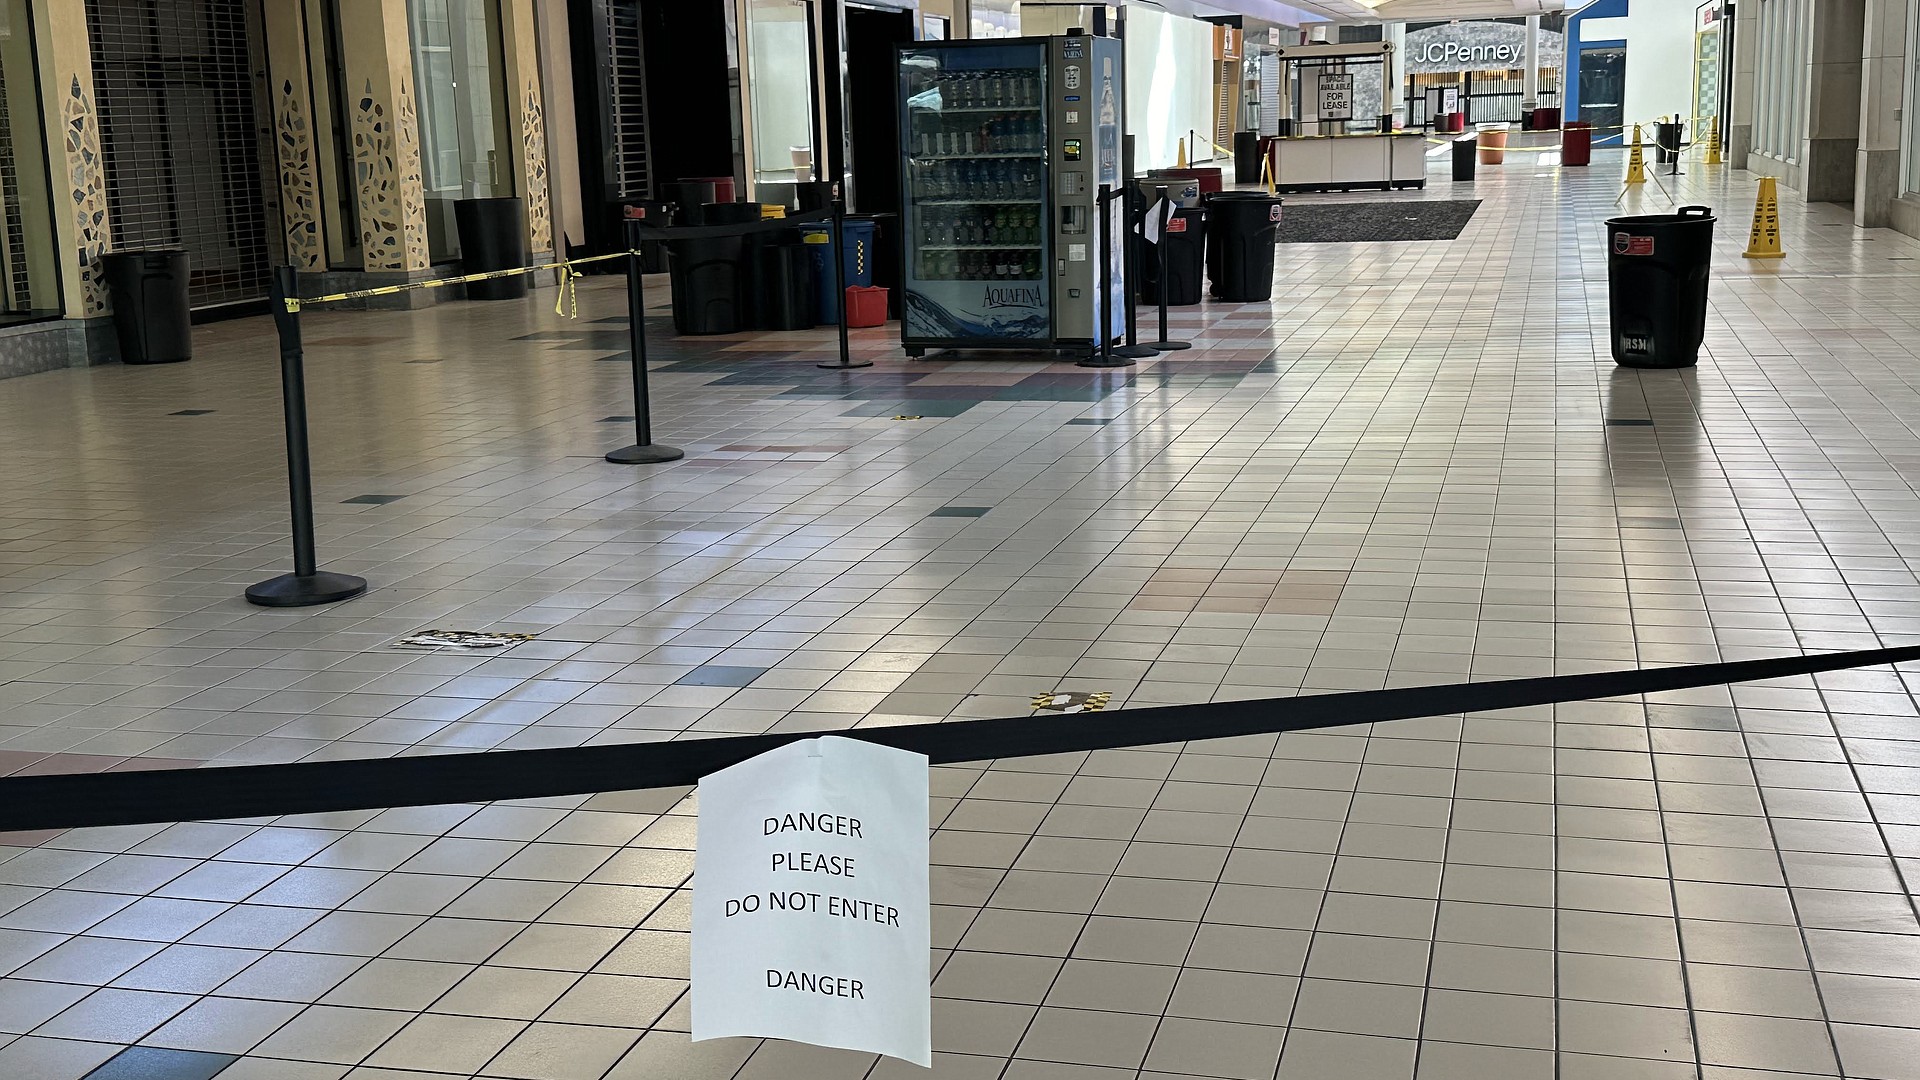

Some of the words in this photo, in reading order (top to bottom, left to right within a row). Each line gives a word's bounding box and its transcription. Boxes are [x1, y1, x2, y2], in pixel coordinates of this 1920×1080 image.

[1414, 42, 1522, 63] JCPenney
[1322, 101, 1348, 110] LEASE
[1326, 92, 1344, 101] FOR
[982, 284, 1044, 308] AQUAFINA
[764, 813, 862, 838] DANGER
[773, 853, 854, 877] PLEASE
[726, 895, 759, 917] DO
[770, 892, 820, 912] NOT
[829, 896, 899, 927] ENTER
[767, 970, 864, 999] DANGER
